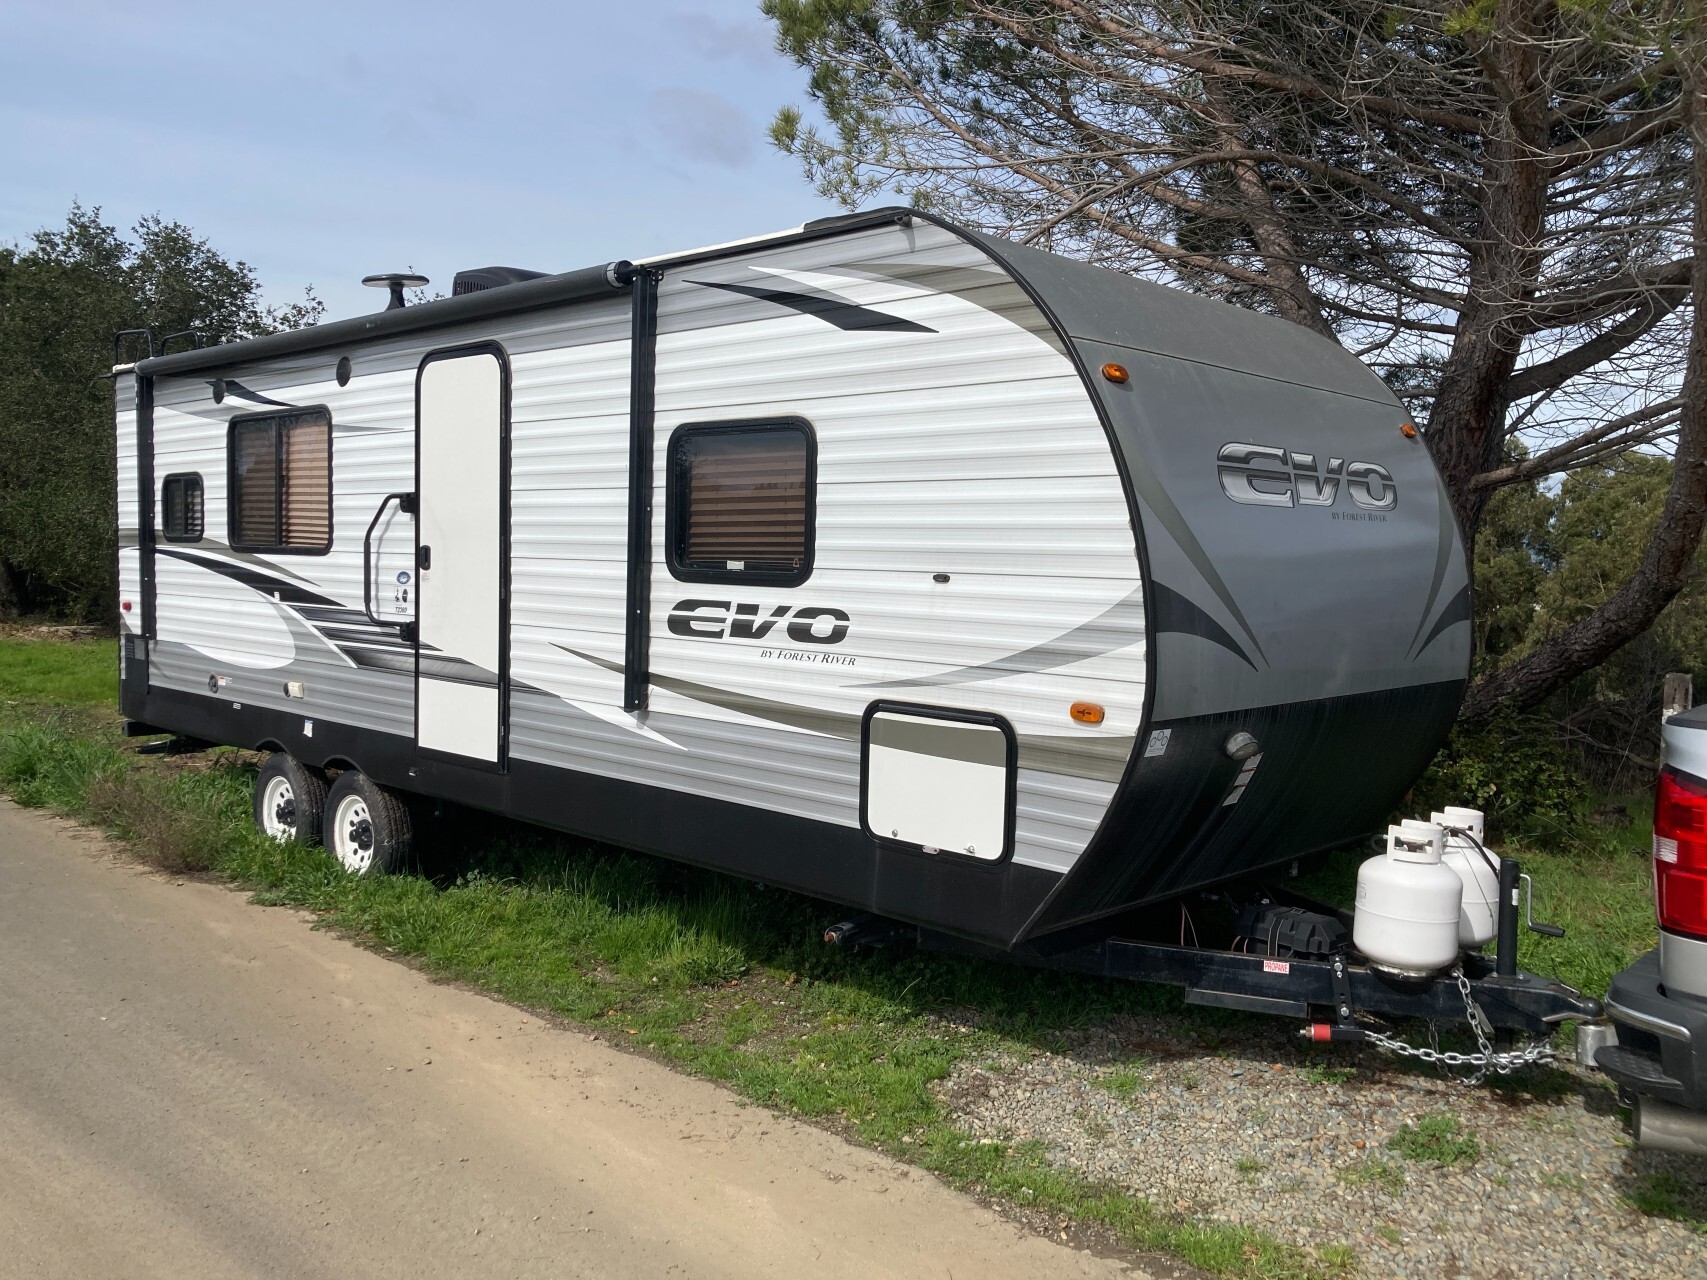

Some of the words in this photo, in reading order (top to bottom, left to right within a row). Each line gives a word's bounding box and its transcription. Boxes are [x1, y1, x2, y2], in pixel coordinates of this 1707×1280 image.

[1217, 441, 1397, 511] EVO
[1331, 511, 1340, 520] BY
[1342, 512, 1366, 521] FOREST
[1368, 513, 1387, 522] RIVER
[667, 598, 851, 645] EVO
[760, 649, 774, 659] BY
[777, 650, 819, 662] FOREST
[821, 653, 856, 666] RIVER
[1265, 961, 1288, 973] PROPANE
